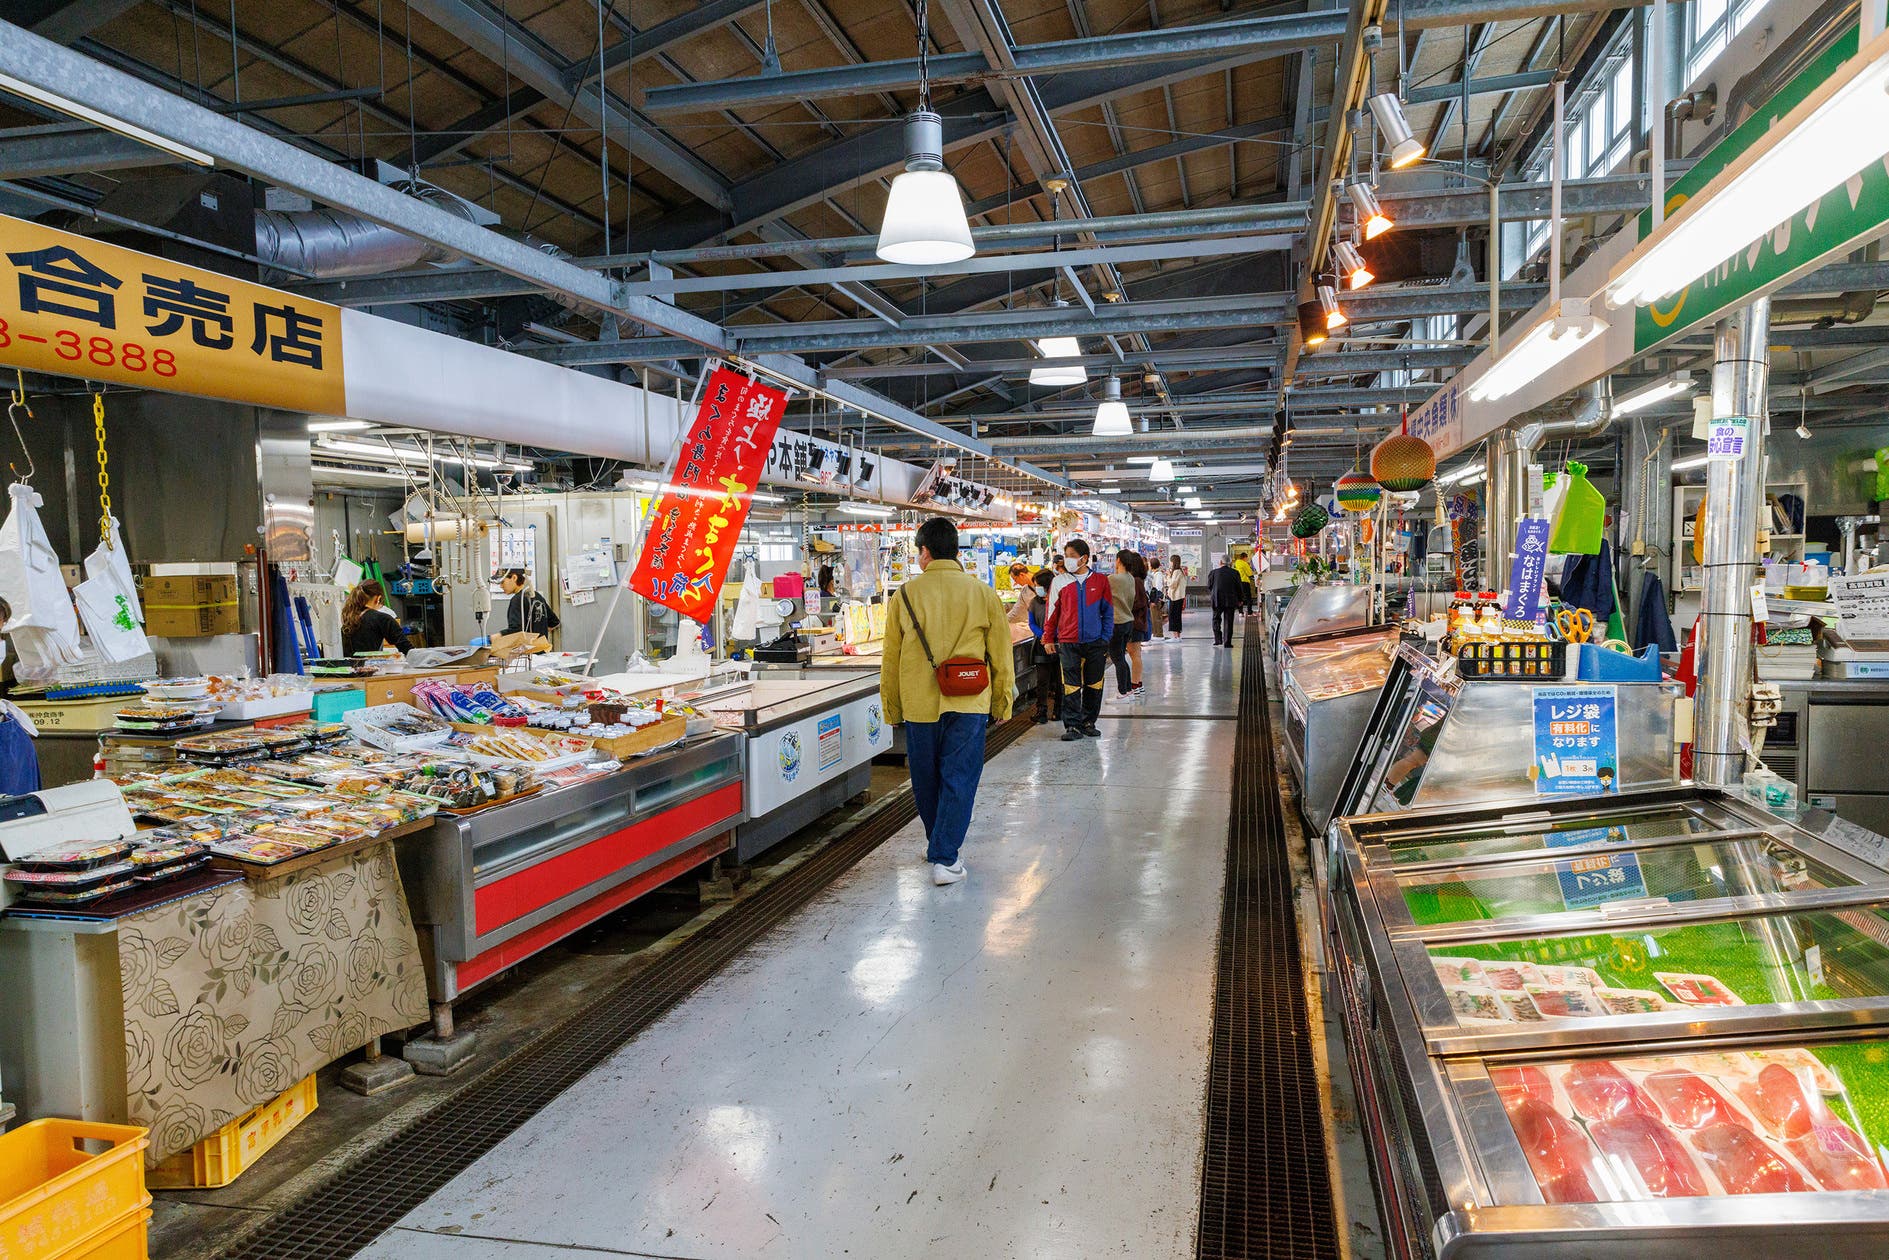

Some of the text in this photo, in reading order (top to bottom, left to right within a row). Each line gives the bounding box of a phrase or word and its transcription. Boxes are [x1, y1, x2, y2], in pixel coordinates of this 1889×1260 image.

[6, 245, 324, 370] 合売店
[1514, 555, 1536, 618] なはまぐろ
[1551, 703, 1601, 720] レジ袋
[1552, 723, 1601, 735] 有料化に
[1553, 737, 1601, 748] なります
